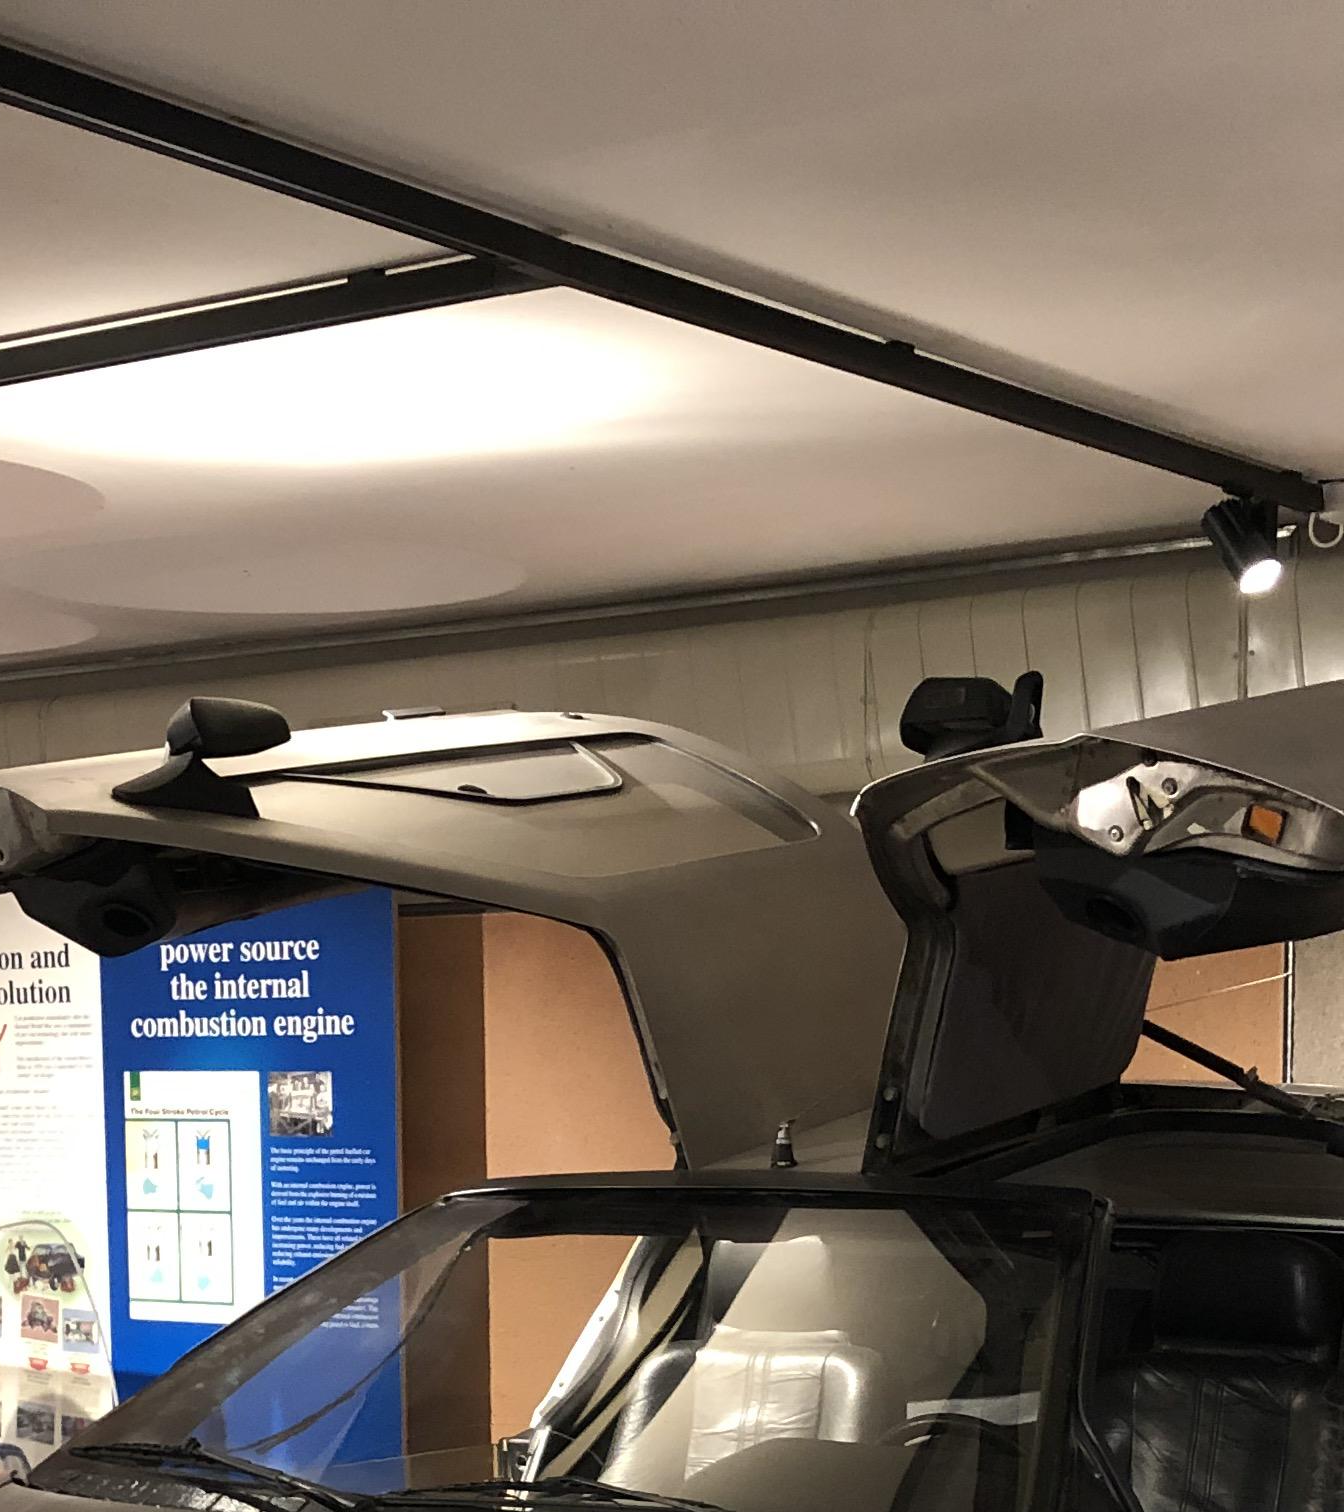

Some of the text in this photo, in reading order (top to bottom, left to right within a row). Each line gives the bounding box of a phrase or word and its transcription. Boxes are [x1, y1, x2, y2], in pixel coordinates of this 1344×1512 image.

[30, 943, 71, 969] and
[160, 939, 320, 972] power source
[170, 970, 310, 1000] the internal
[130, 1008, 268, 1038] combustion
[273, 1007, 355, 1043] engine
[131, 1107, 143, 1115] The
